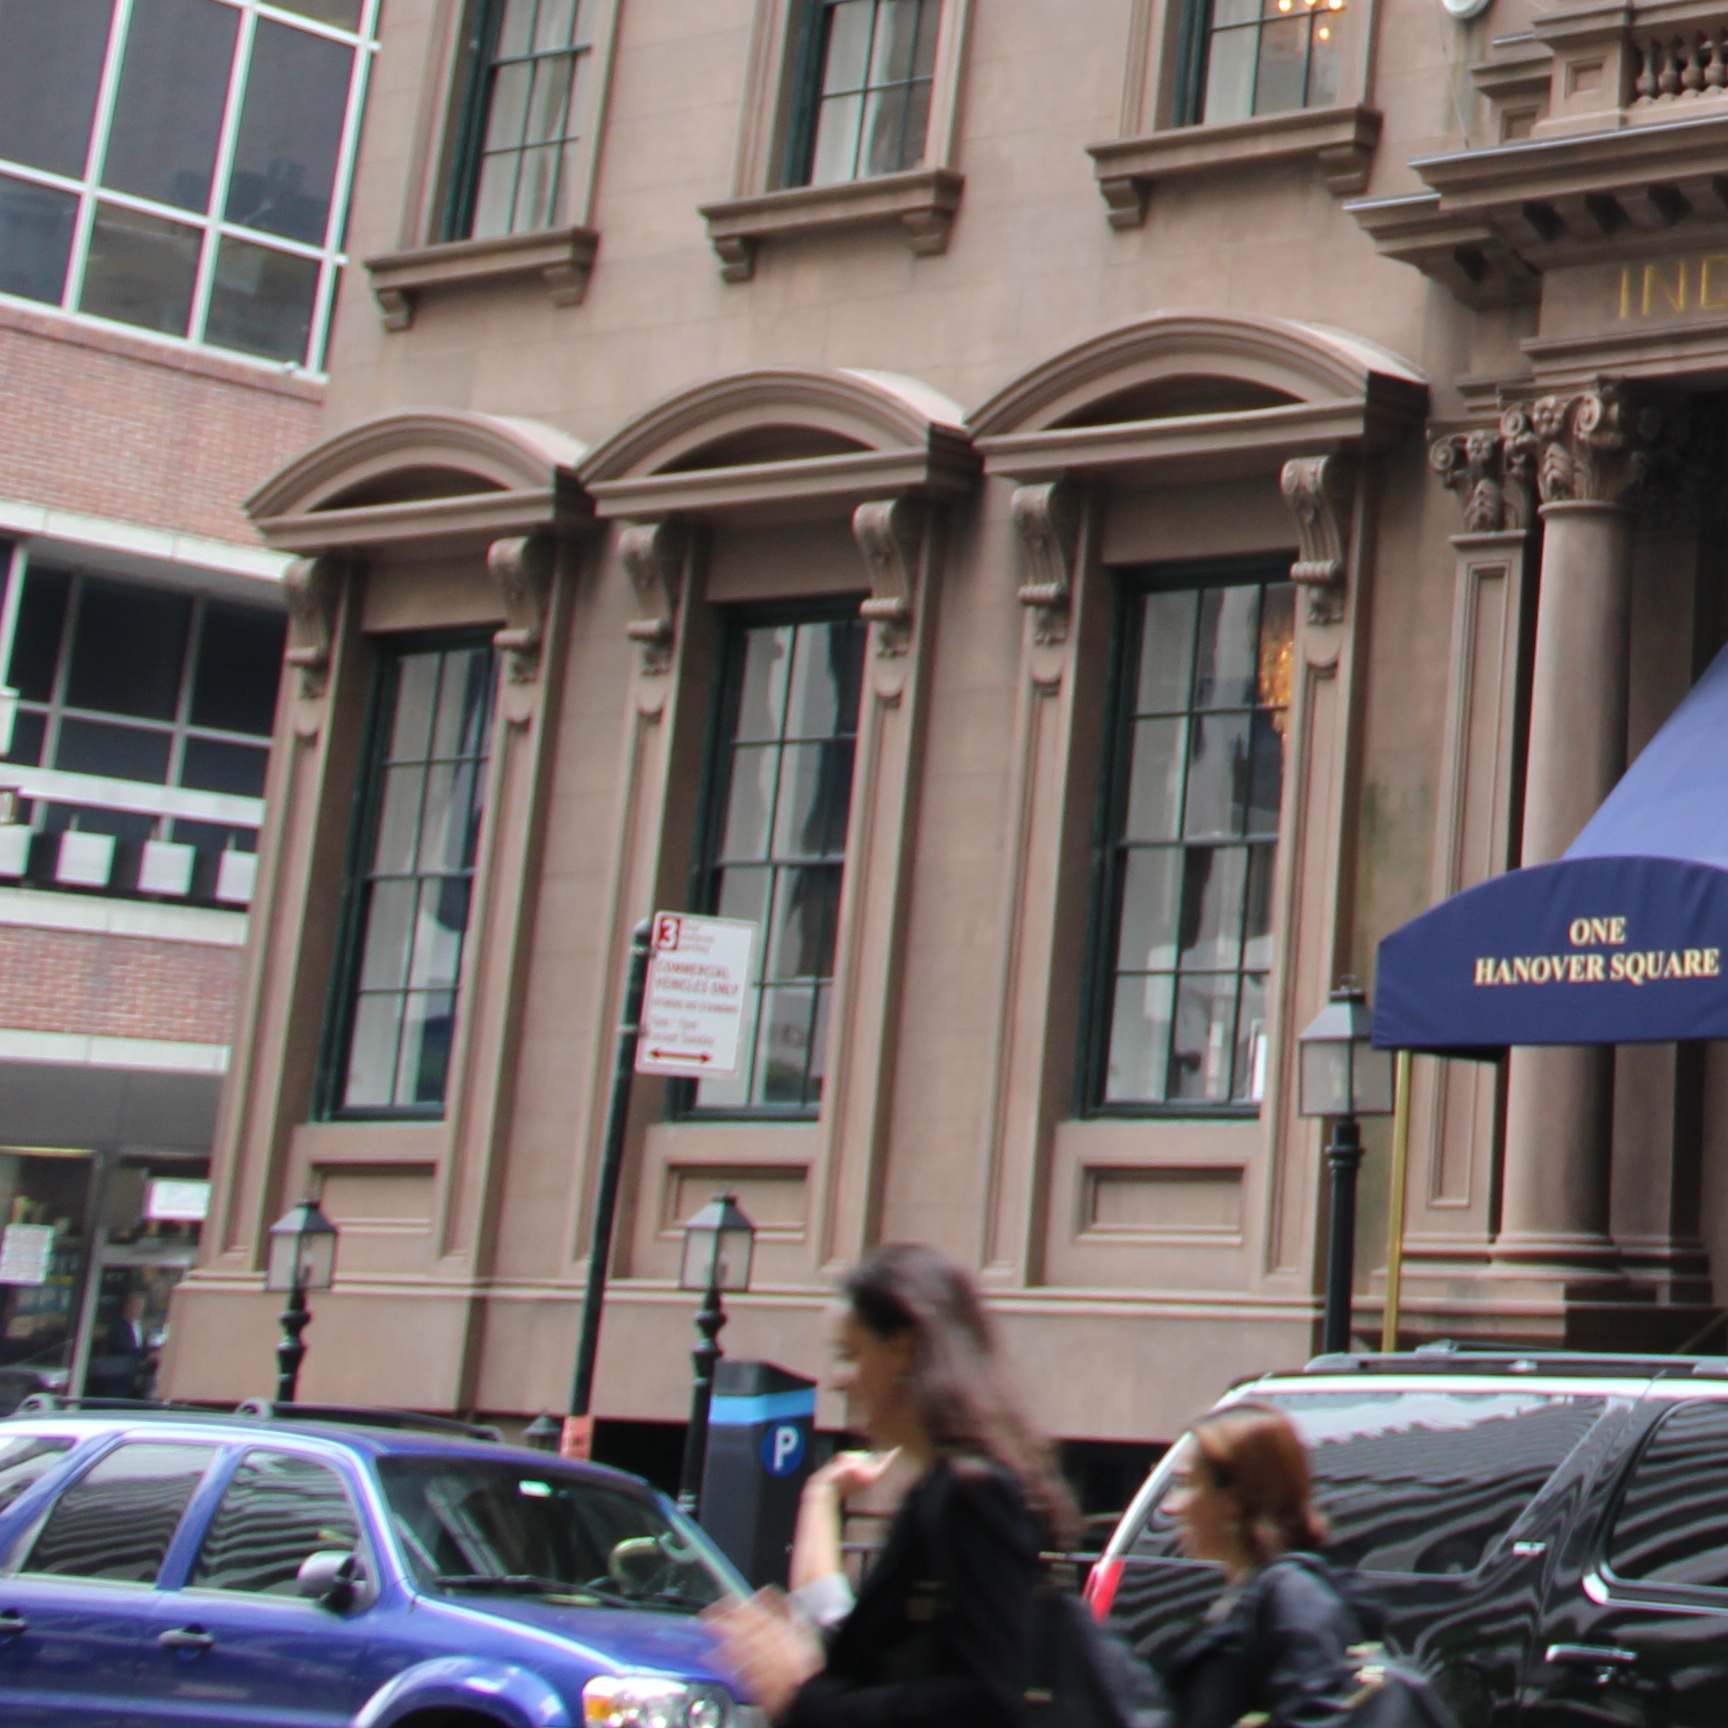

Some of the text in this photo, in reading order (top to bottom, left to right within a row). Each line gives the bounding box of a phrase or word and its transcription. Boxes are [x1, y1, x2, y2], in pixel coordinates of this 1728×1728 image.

[660, 918, 677, 949] 3
[1568, 917, 1626, 946] ONE
[1473, 948, 1721, 986] HANOVER SQUARE
[773, 1425, 799, 1471] P
